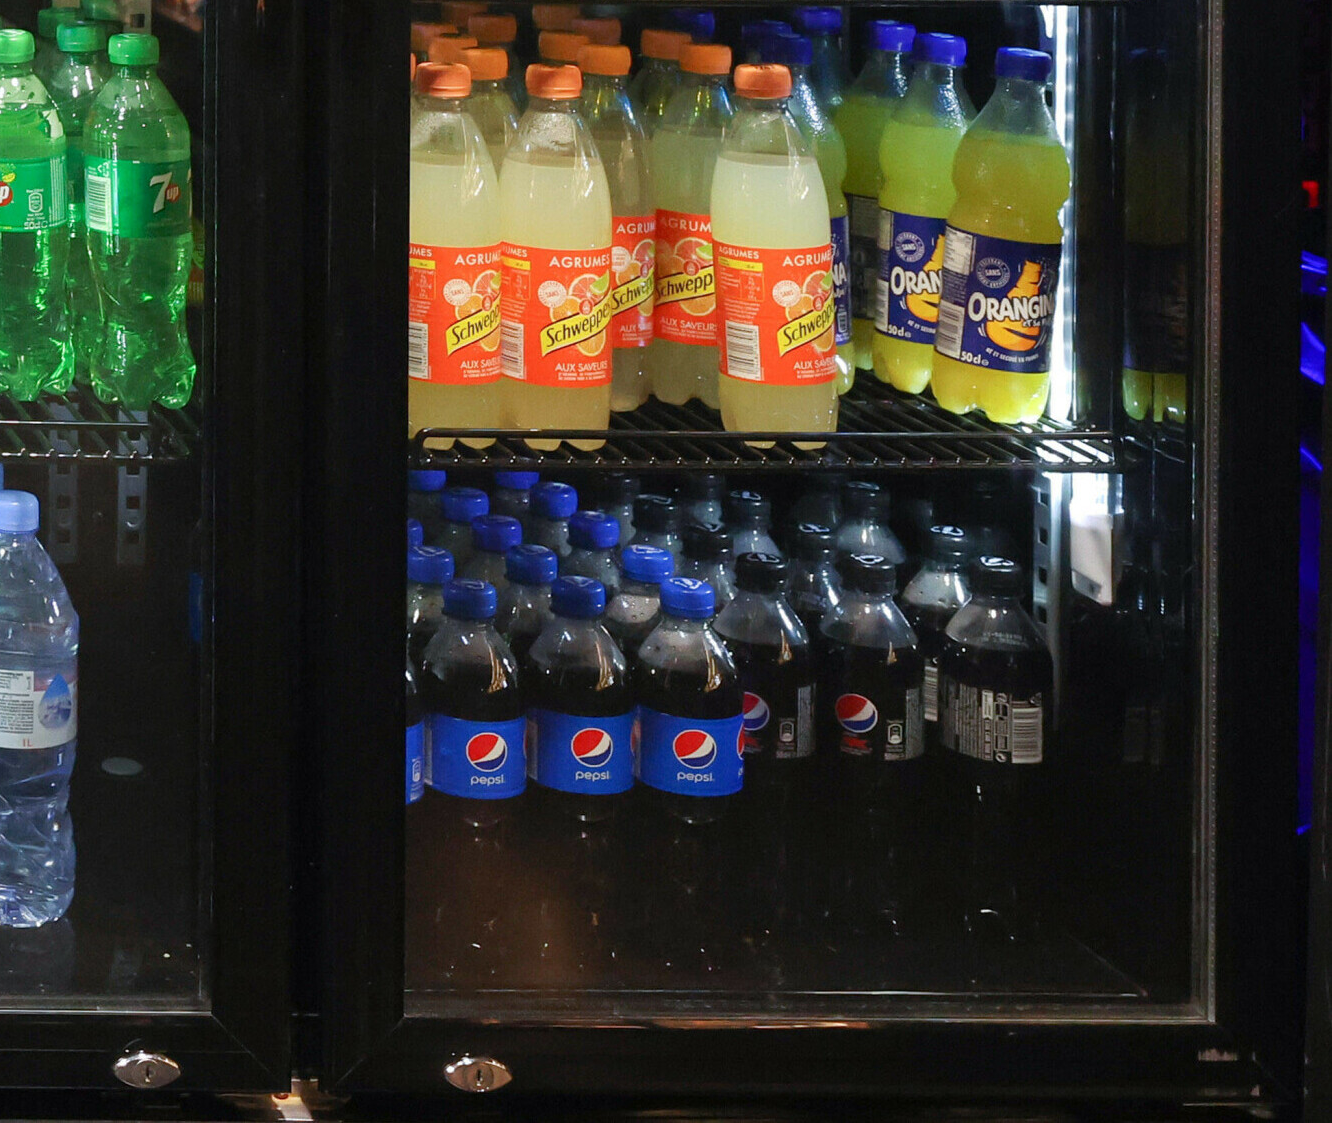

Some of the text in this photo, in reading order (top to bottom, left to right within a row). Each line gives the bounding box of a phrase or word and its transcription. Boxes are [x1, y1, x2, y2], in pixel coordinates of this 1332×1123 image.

[149, 171, 179, 213] 7 up
[901, 243, 916, 251] SANS
[718, 246, 759, 260] AGRUMES
[549, 254, 610, 268] AGRUMES
[985, 269, 1001, 277] SANS
[779, 290, 795, 298] SANS
[660, 318, 678, 328] AUX
[460, 360, 479, 370] AUX
[555, 360, 607, 372] AUX SAVEURS
[793, 361, 812, 371] AUX
[22, 738, 32, 747] 1L
[470, 774, 504, 786] pepsi
[575, 770, 609, 782] pepsi
[677, 771, 713, 783] pepsi
